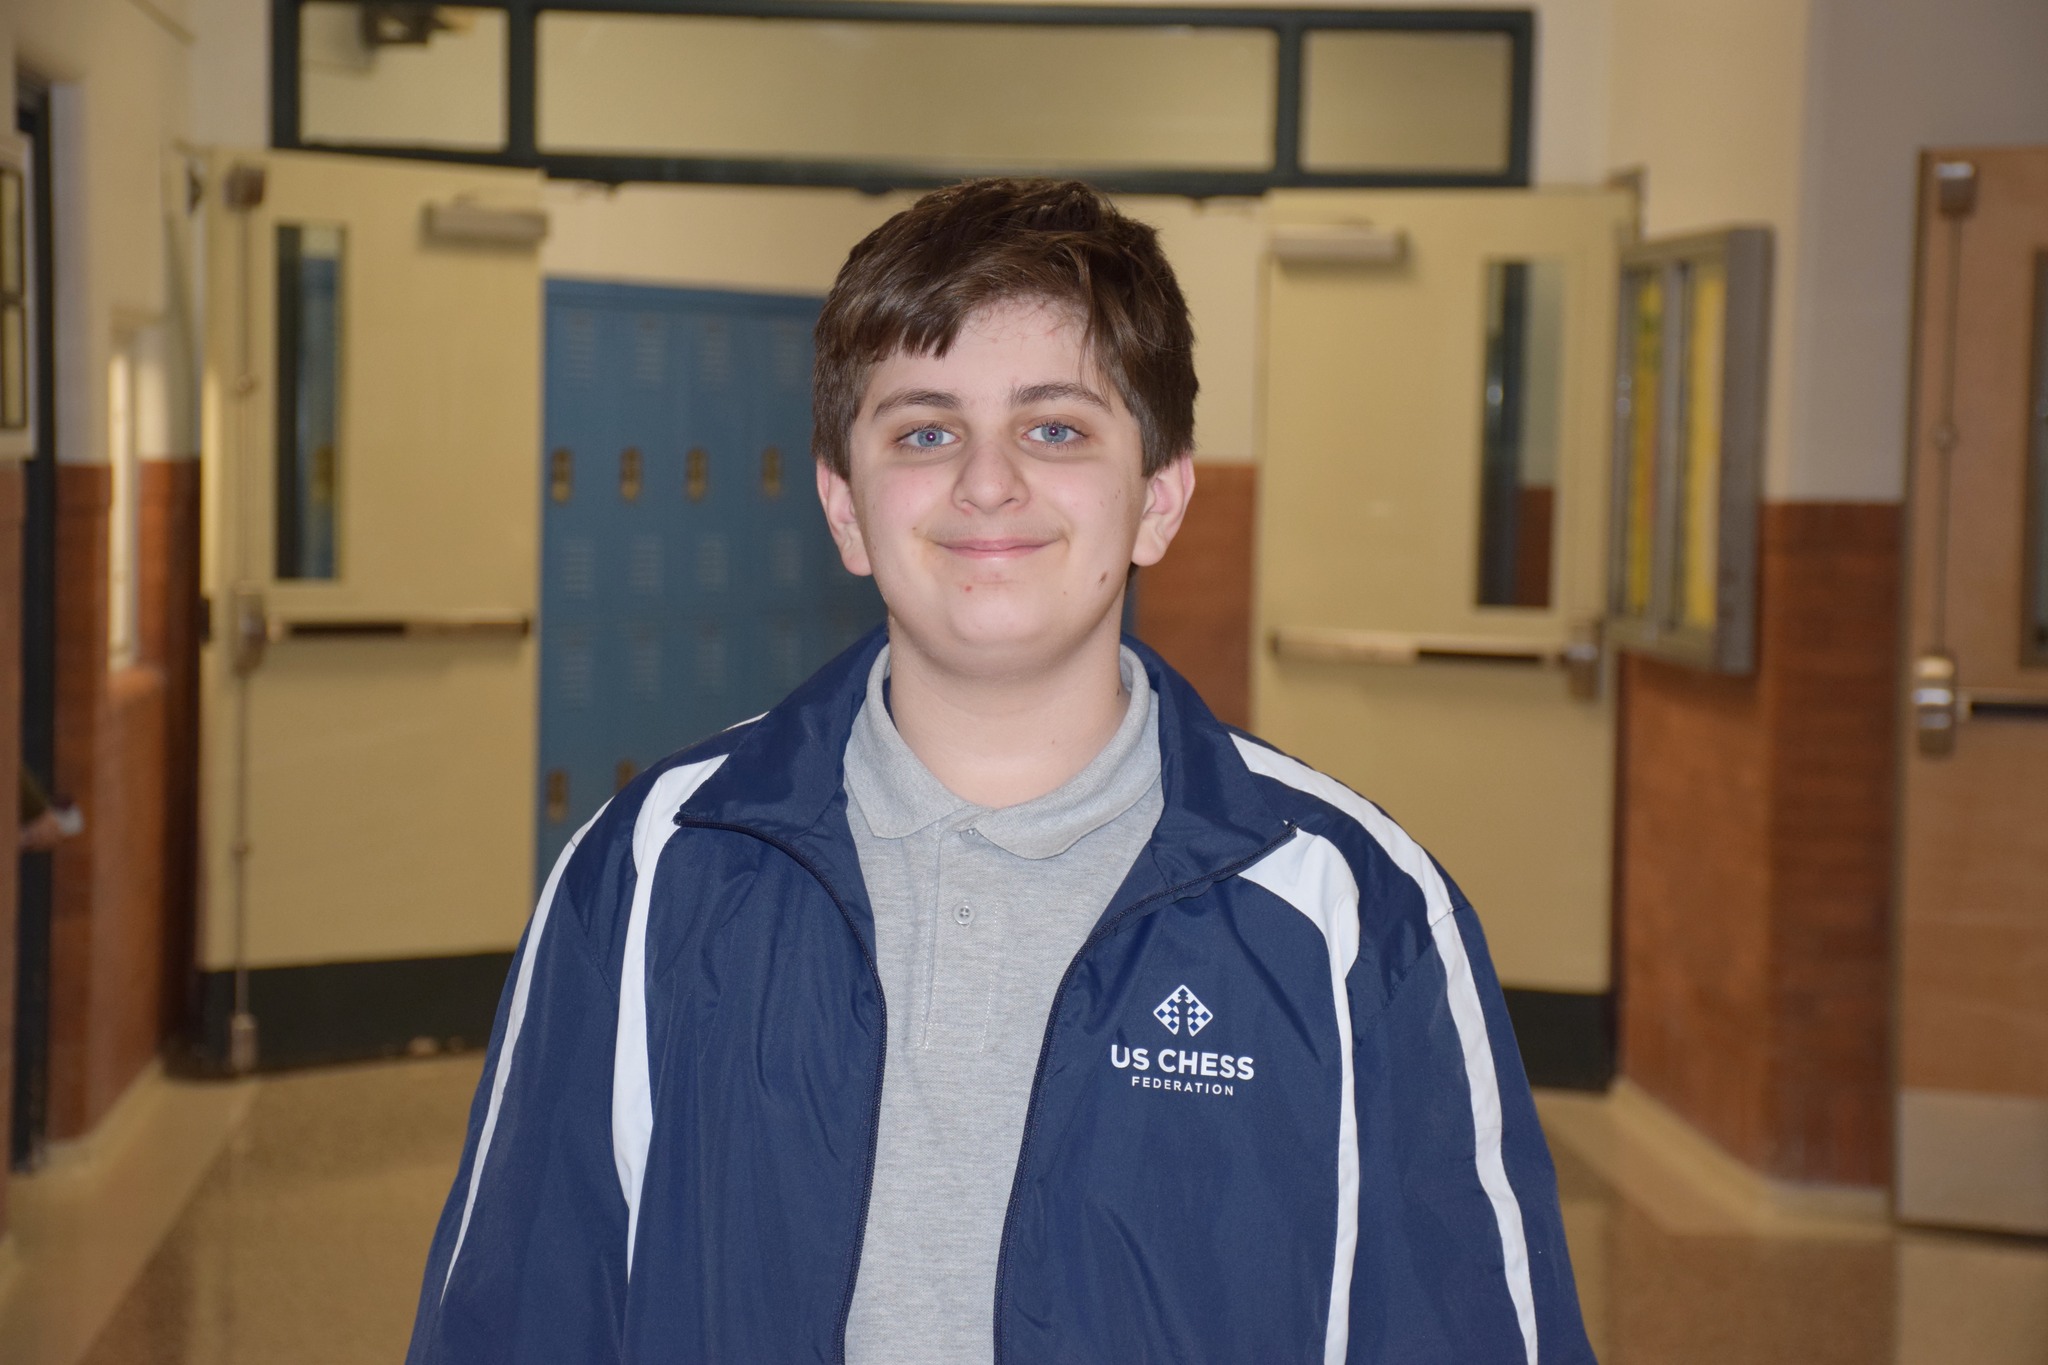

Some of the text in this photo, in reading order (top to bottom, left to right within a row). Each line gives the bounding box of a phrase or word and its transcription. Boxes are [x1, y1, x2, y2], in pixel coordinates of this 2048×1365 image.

[1111, 1044, 1255, 1080] US CHESS
[1131, 1076, 1234, 1096] FEDERATION
